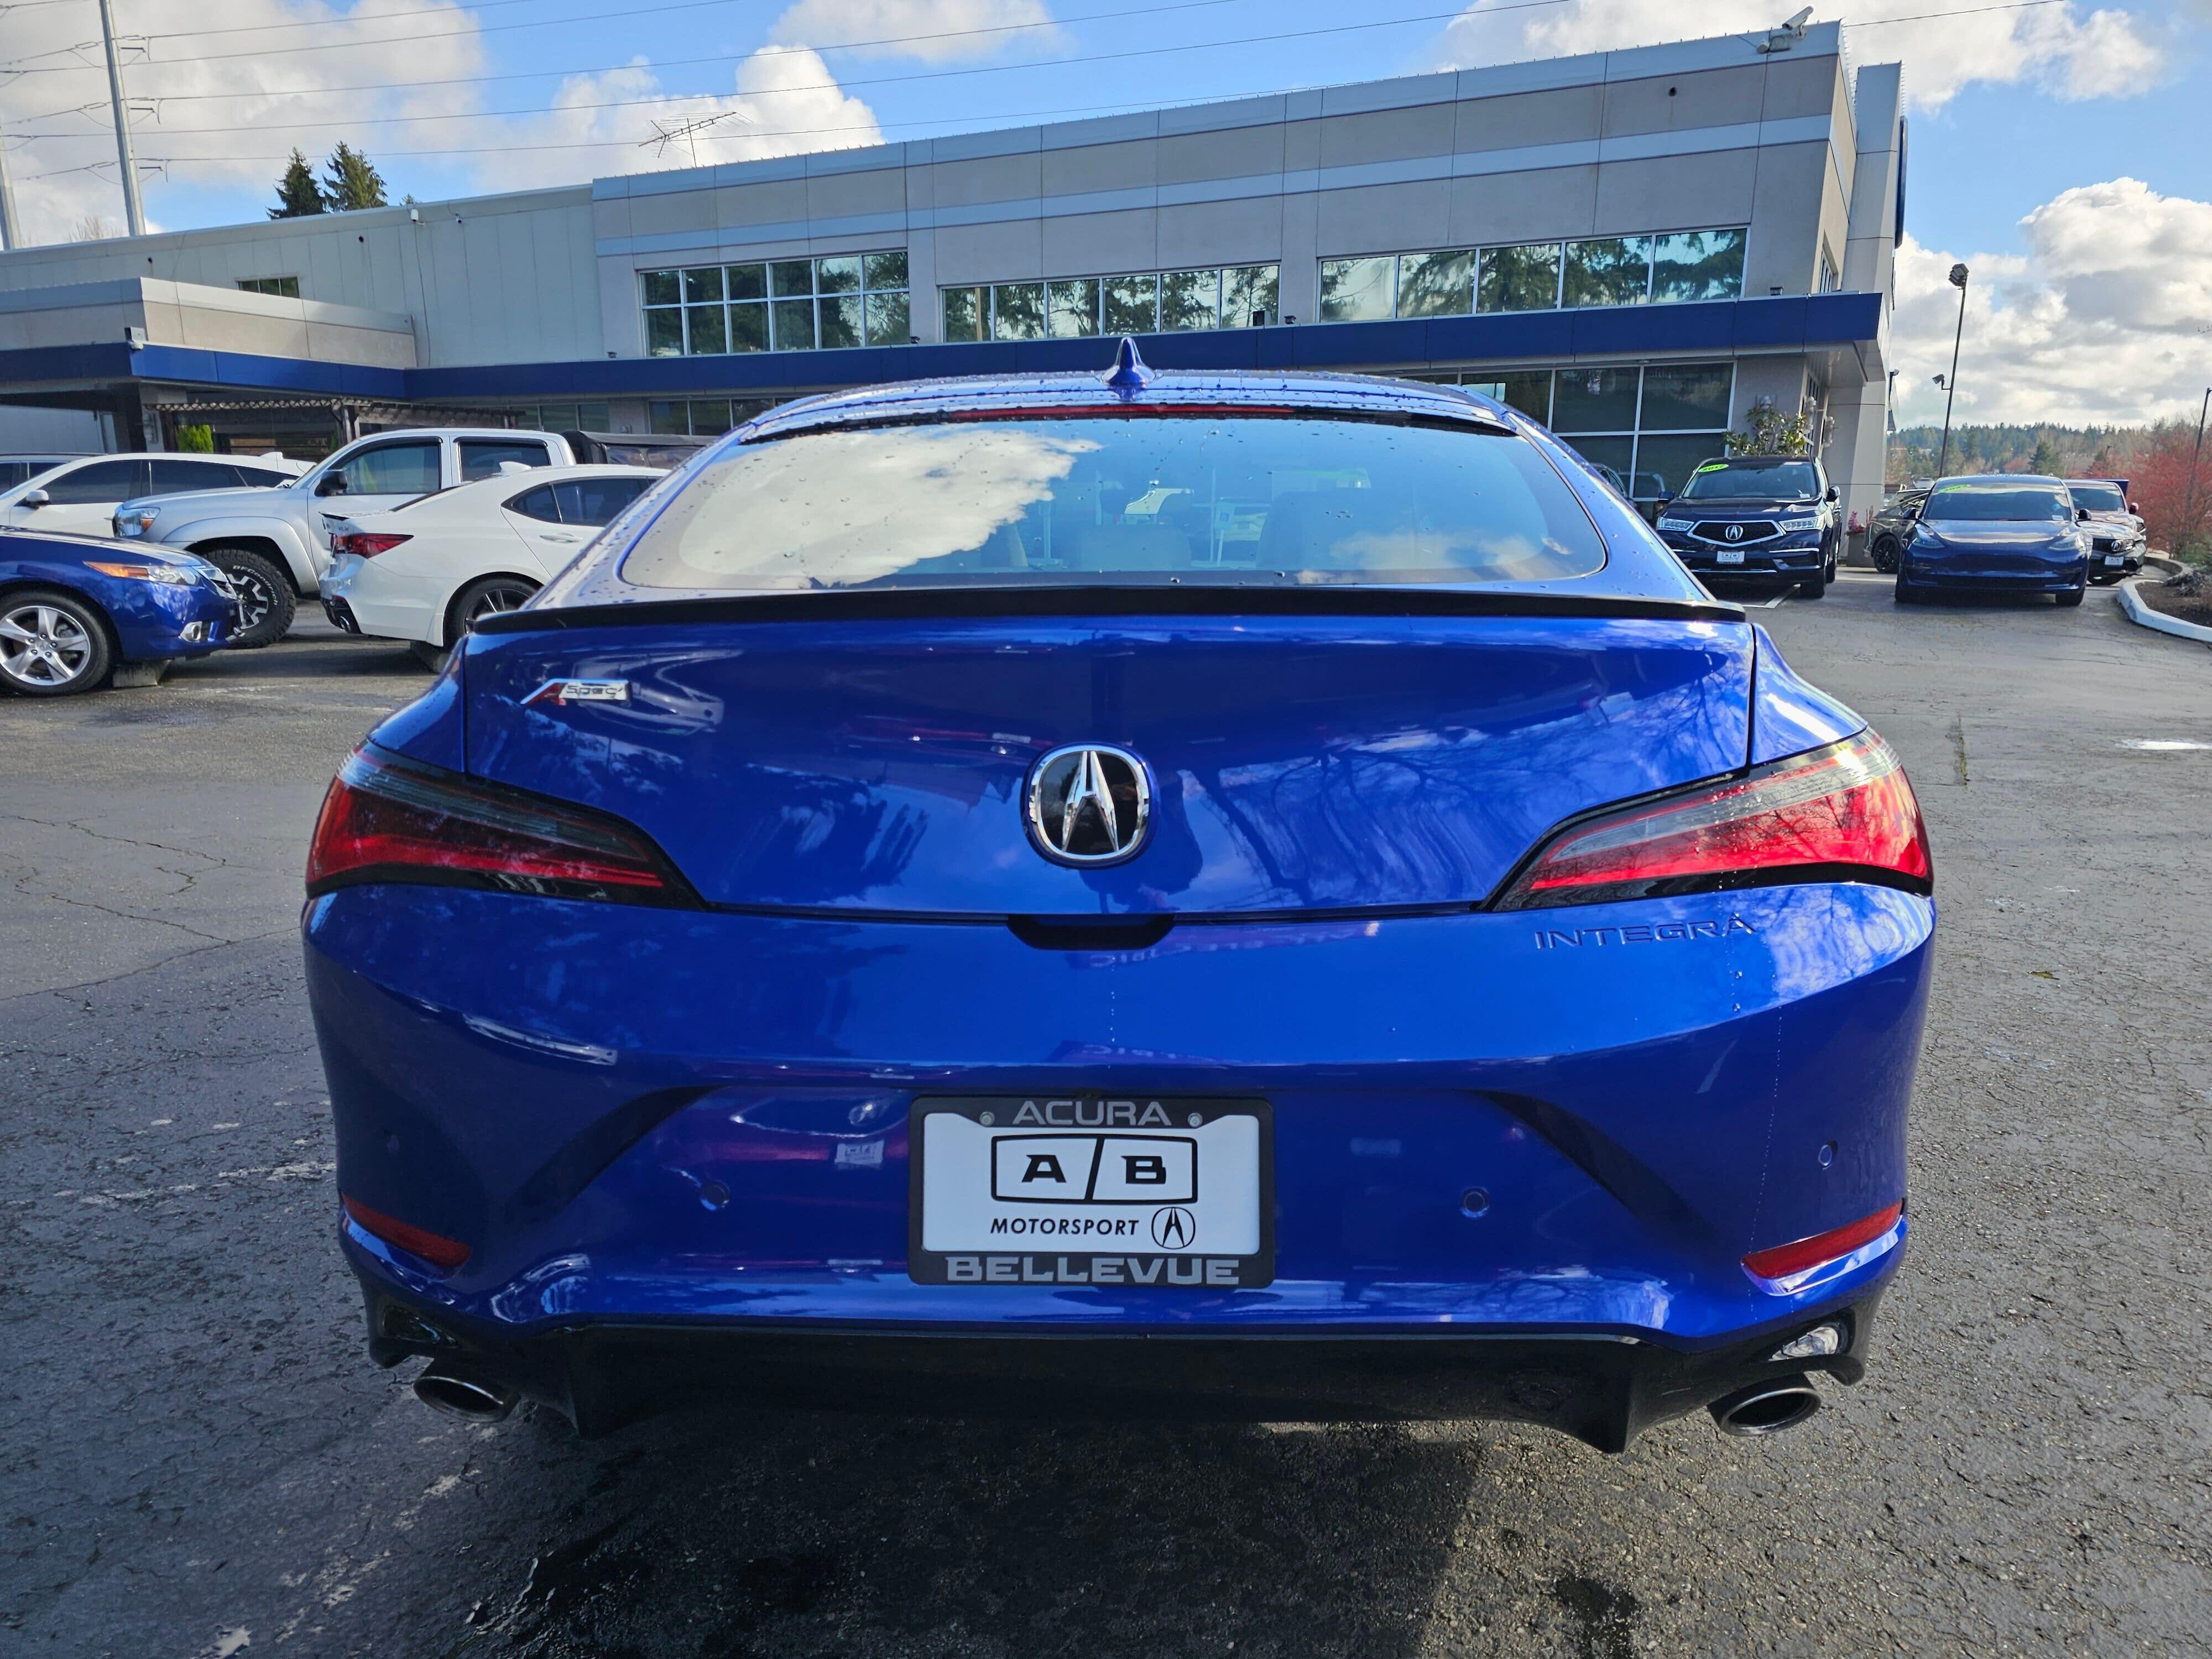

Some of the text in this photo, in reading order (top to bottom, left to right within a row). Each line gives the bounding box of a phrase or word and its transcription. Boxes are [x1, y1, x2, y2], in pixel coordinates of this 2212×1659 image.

[1535, 912, 1756, 949] INTEGRA
[1011, 1100, 1172, 1126] ACURA
[990, 1218, 1140, 1236] MOTORSPORT
[945, 1256, 1240, 1285] BELLEVUE
